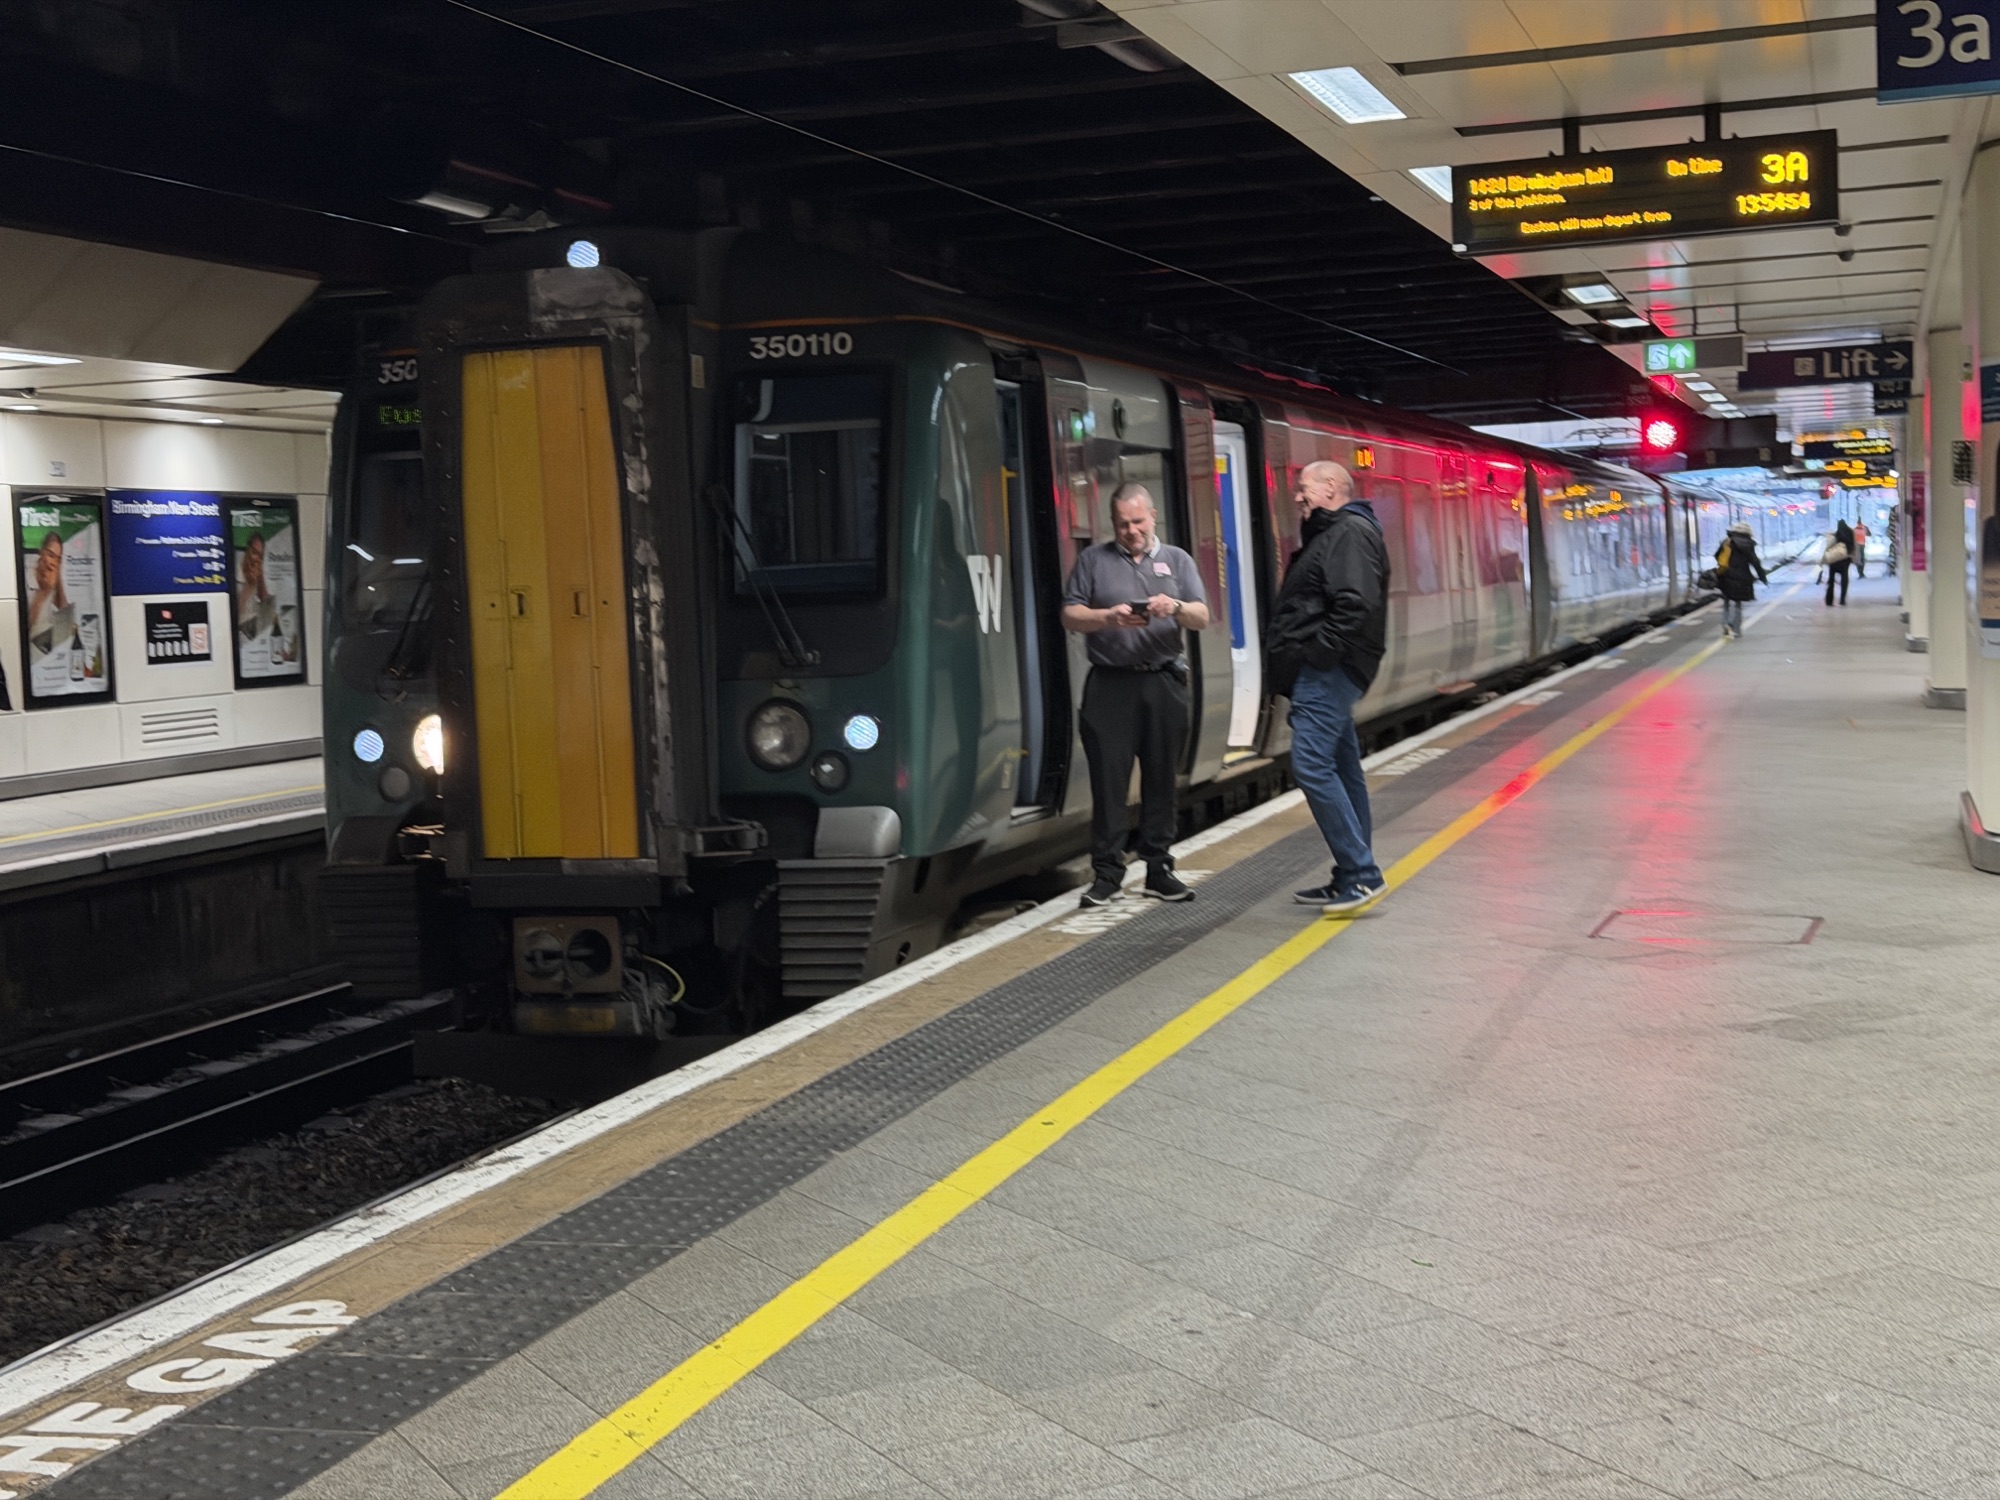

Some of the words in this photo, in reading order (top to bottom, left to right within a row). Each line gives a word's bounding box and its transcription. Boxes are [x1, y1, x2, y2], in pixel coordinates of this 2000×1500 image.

[1896, 0, 1991, 68] 3a
[1762, 151, 1809, 183] 3A
[749, 331, 853, 360] 350110
[1822, 348, 1880, 379] Lift
[112, 499, 169, 518] Birmingham
[189, 500, 220, 516] Street
[0, 1402, 187, 1500] HE
[126, 1299, 359, 1394] GAP
